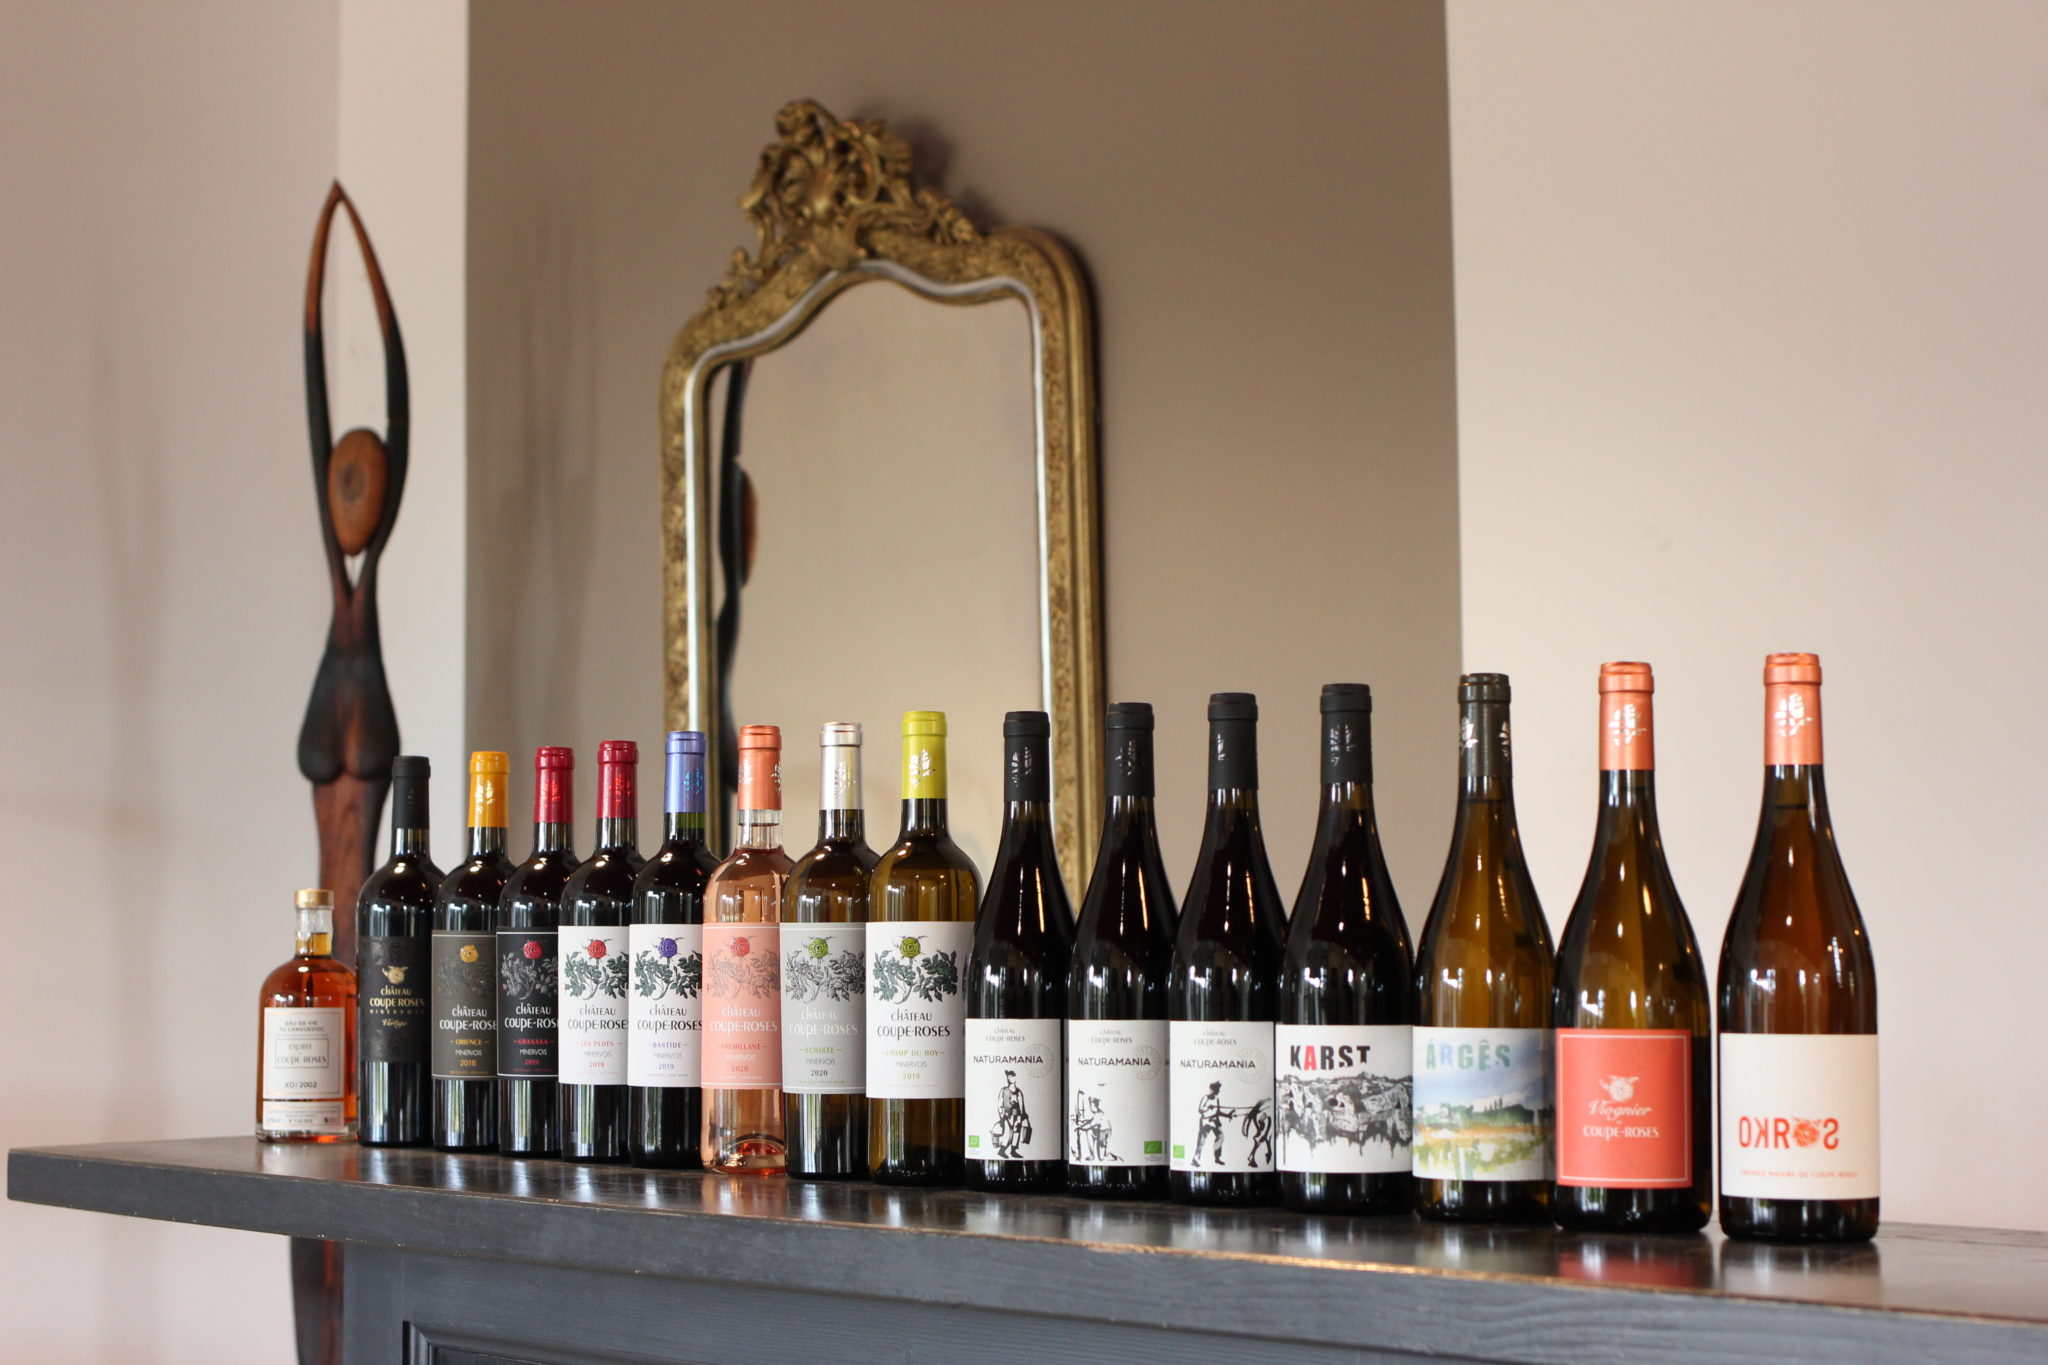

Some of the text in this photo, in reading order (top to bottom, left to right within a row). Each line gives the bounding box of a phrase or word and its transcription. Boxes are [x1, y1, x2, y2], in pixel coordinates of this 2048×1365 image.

[451, 1004, 488, 1017] CHÂTEAU
[515, 1002, 552, 1015] CHÂTEAU
[579, 1004, 616, 1016] CHÂTEAU
[649, 1005, 688, 1017] CHÂTEAU
[722, 1005, 761, 1017] CHÂTEAU
[801, 1007, 840, 1020] CHÂTEAU
[891, 1008, 933, 1021] CHÂTEAU
[710, 1020, 778, 1036] COUPE-ROSES
[789, 1022, 858, 1039] COUPE-ROSES
[877, 1025, 951, 1041] COUPE-ROSES
[985, 1035, 1026, 1044] COUPE-ROSES
[1091, 1037, 1133, 1045] COUPE-ROSES
[1193, 1038, 1237, 1047] COUPE-ROSES
[583, 1050, 612, 1058] MINERVOIS
[653, 1052, 683, 1060] MINERVOIS
[973, 1055, 1044, 1064] NATURAMANIA
[1290, 1045, 1371, 1071] KARST
[895, 1061, 928, 1069] MINERVOIS
[1078, 1057, 1151, 1066] NATURAMANIA
[1180, 1060, 1256, 1069] NATURAMANIA
[810, 1069, 828, 1077] 2020
[1589, 1099, 1653, 1120] Viognier
[1583, 1126, 1660, 1142] COUPE-ROSES
